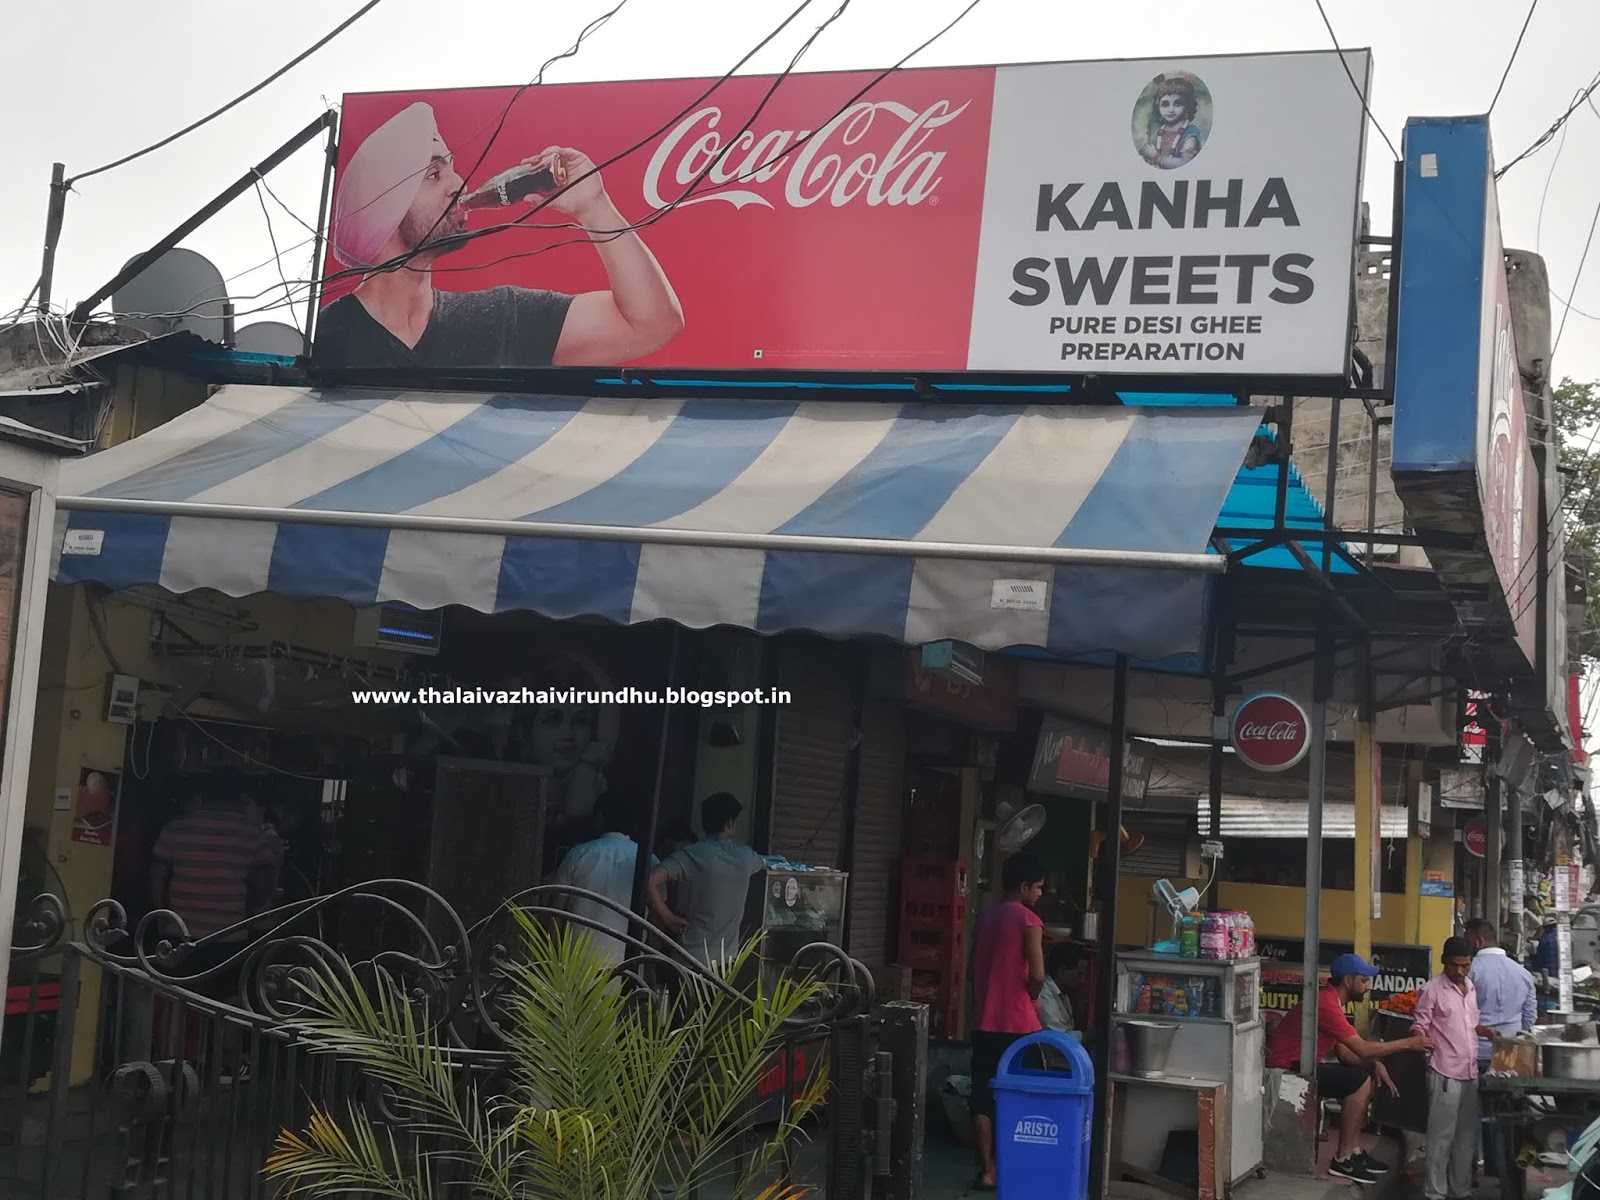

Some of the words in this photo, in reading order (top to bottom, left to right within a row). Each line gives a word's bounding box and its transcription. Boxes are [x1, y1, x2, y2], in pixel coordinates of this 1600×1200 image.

[643, 99, 972, 210] Coca-Cola
[1035, 177, 1301, 232] KANHA
[1008, 253, 1315, 306] SWEETS
[1049, 316, 1117, 334] PURE
[1124, 316, 1182, 334] DESI
[1190, 315, 1263, 334] GHEE
[1060, 342, 1245, 361] PREPARATION
[1240, 720, 1299, 741] Coca-Cola
[1260, 943, 1287, 957] New
[1259, 992, 1299, 1010] OUTH
[1014, 1120, 1059, 1137] ARISTO
